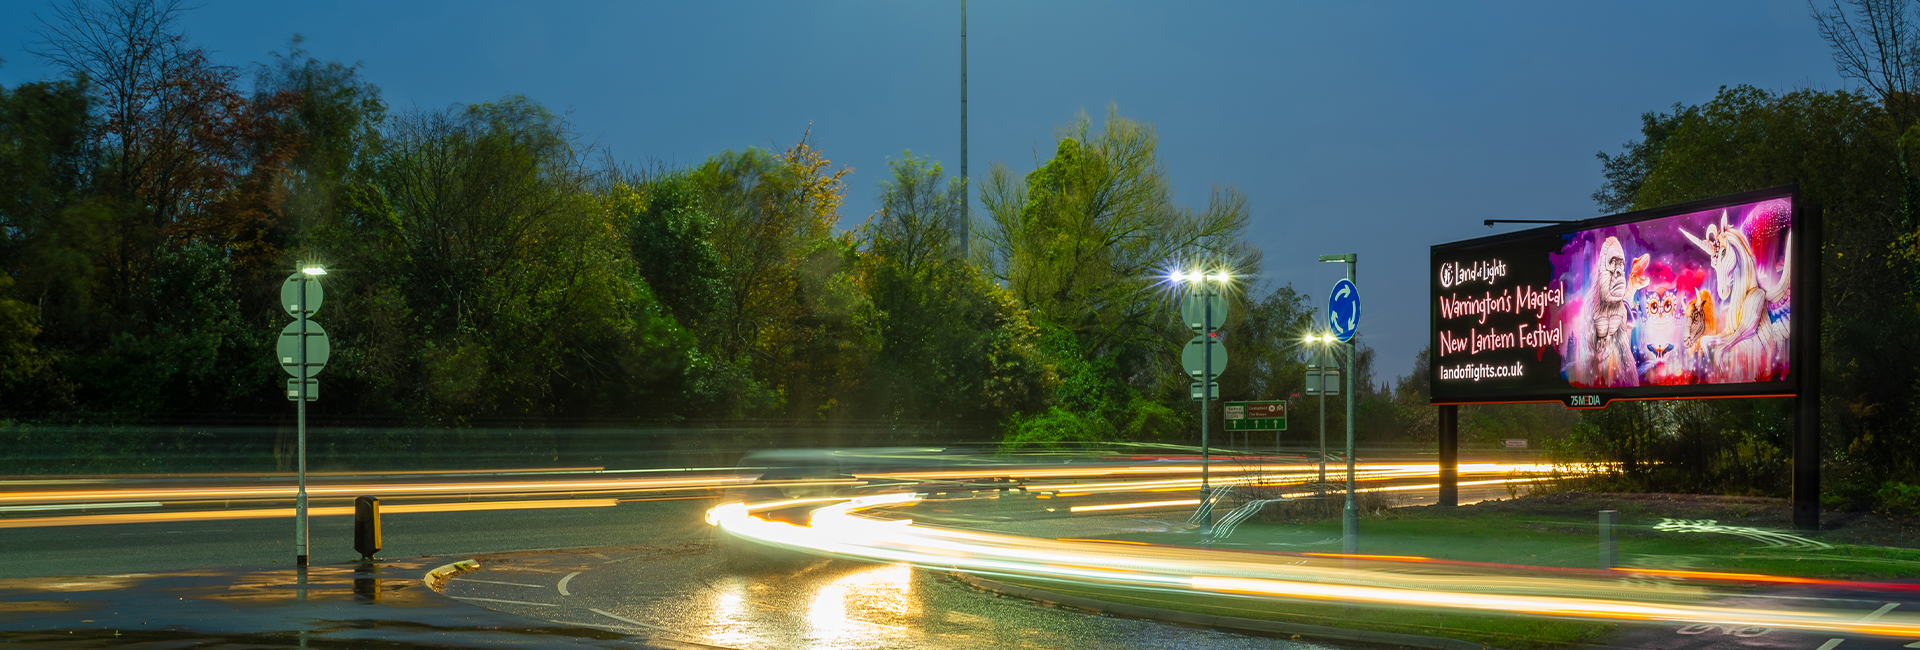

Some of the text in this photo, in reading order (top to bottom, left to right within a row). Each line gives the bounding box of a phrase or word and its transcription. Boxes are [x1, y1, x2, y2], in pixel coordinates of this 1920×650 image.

[1455, 259, 1506, 286] Land of Lights
[1440, 281, 1564, 324] Warrington's Magical
[1440, 320, 1563, 357] New Lantern Festival
[1440, 361, 1523, 382] landoflights.co.uk
